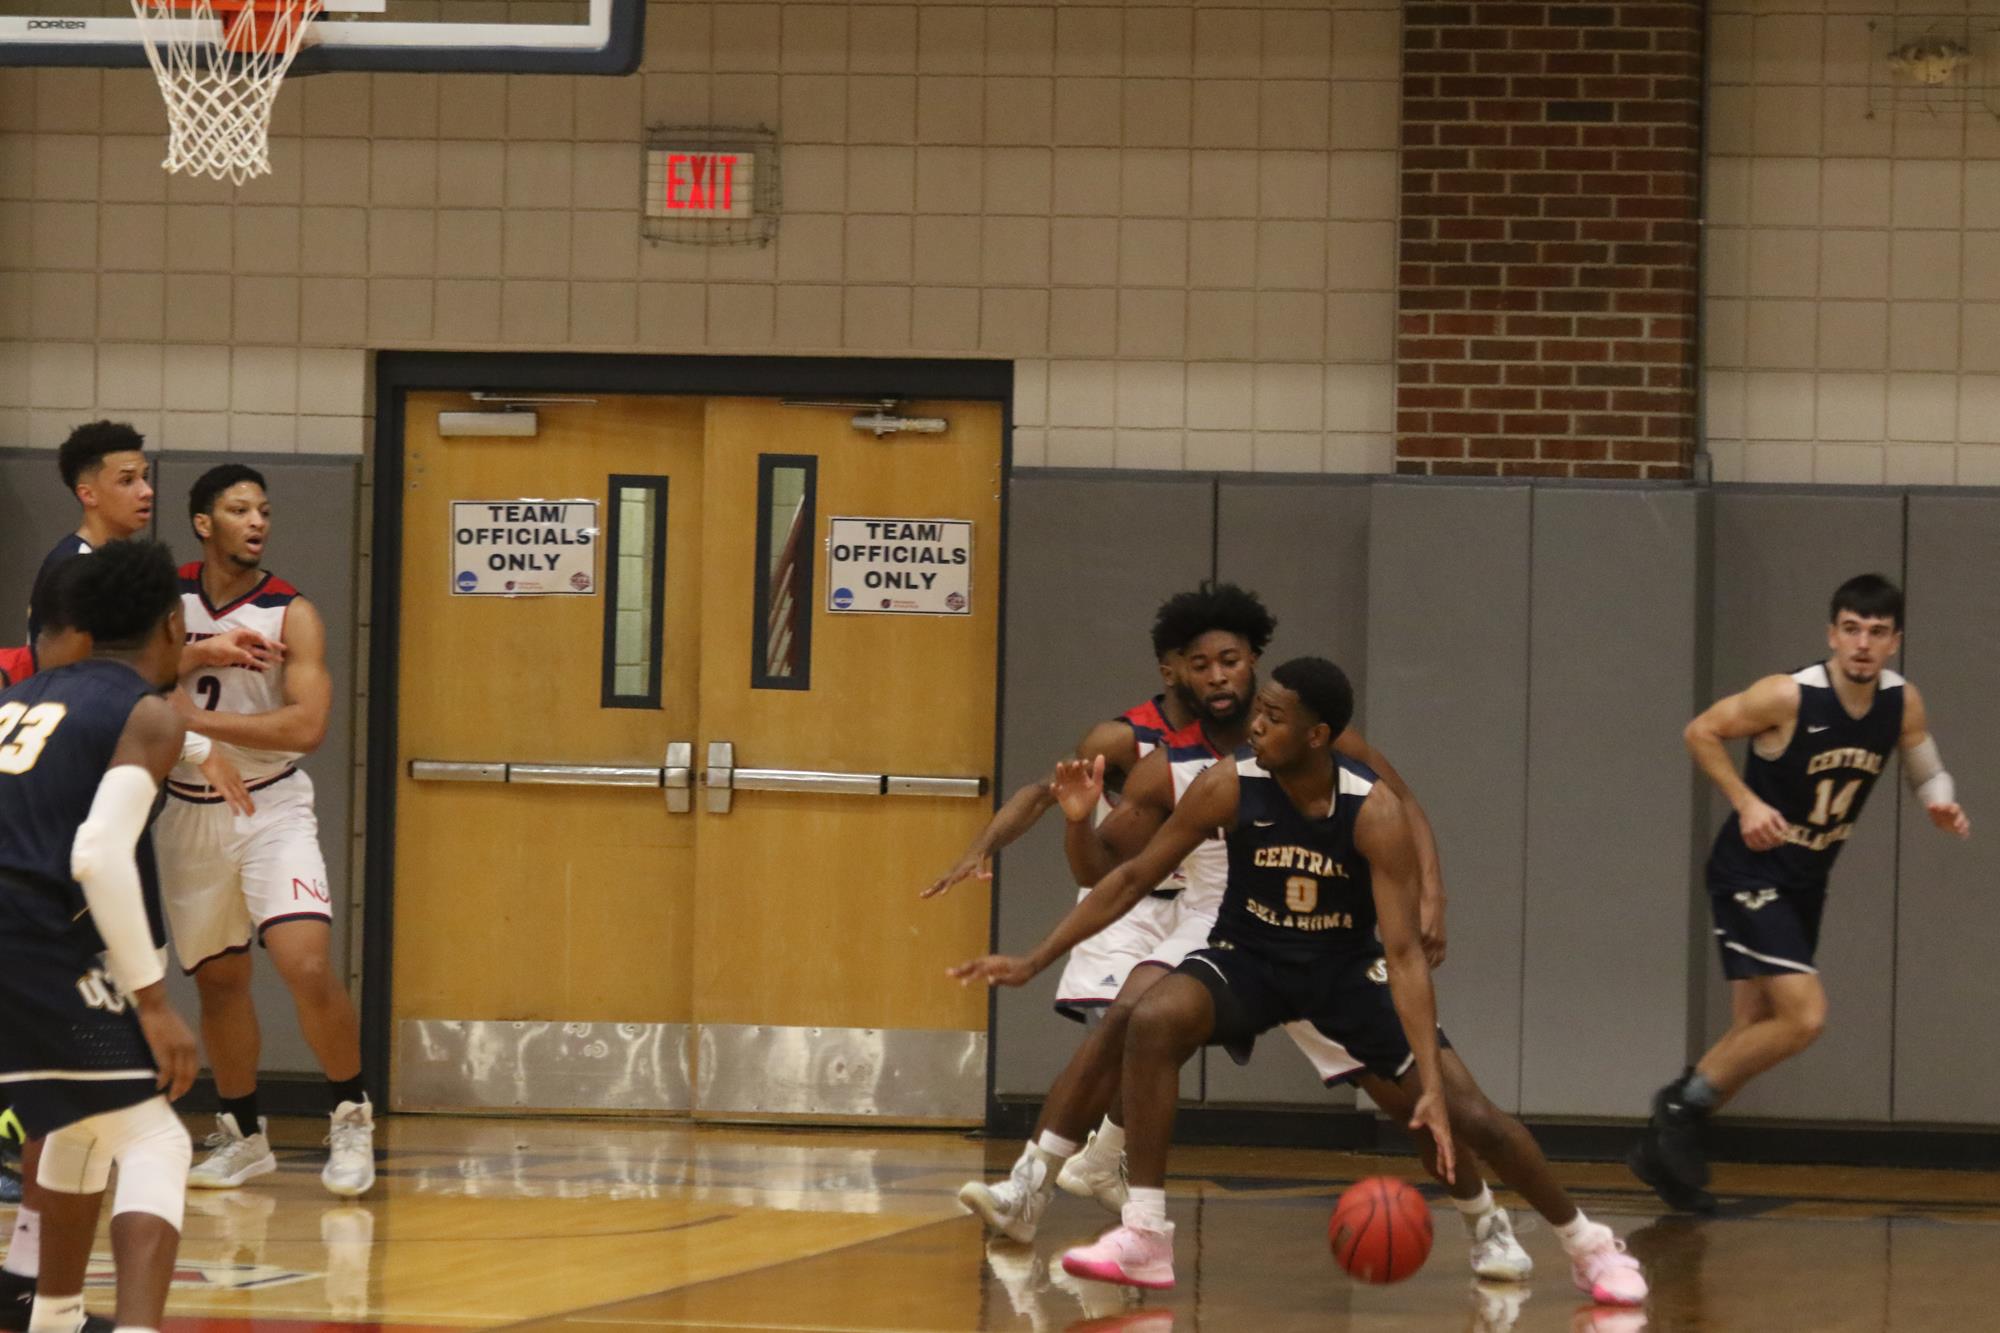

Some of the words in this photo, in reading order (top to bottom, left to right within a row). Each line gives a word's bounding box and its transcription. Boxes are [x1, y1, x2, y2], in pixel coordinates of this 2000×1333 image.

[667, 154, 737, 210] EXIT
[488, 505, 568, 524] TEAM/
[456, 528, 592, 546] OFFICIALS
[866, 522, 945, 542] TEAM/
[488, 553, 561, 571] ONLY
[833, 545, 967, 565] OFFICIALS
[864, 571, 937, 590] ONLY
[1808, 779, 1863, 825] 14
[1285, 875, 1318, 913] 0
